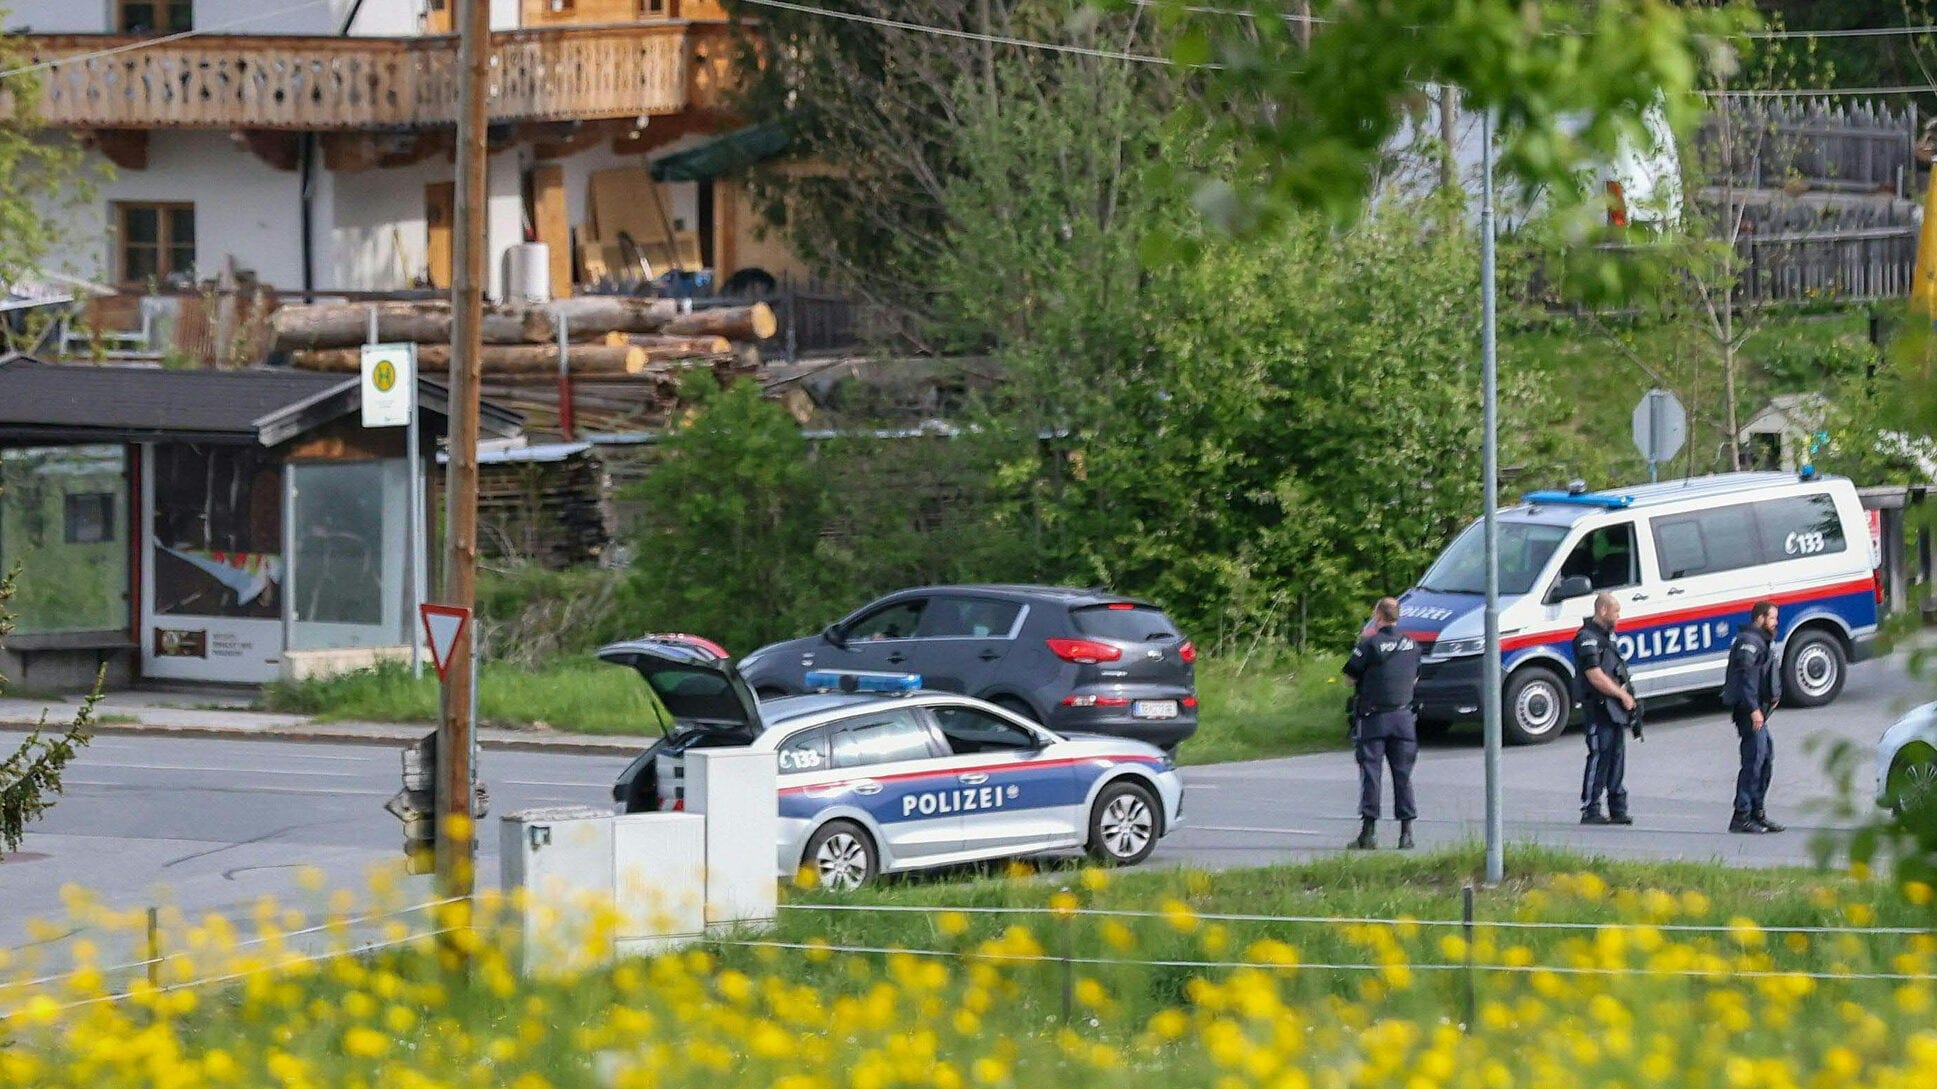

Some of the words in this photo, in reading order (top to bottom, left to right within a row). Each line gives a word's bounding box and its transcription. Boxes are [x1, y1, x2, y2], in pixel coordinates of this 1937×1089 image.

[1399, 605, 1454, 621] OLIZEI
[1610, 622, 1712, 661] OLIZEI
[902, 786, 1003, 817] POLIZEI
